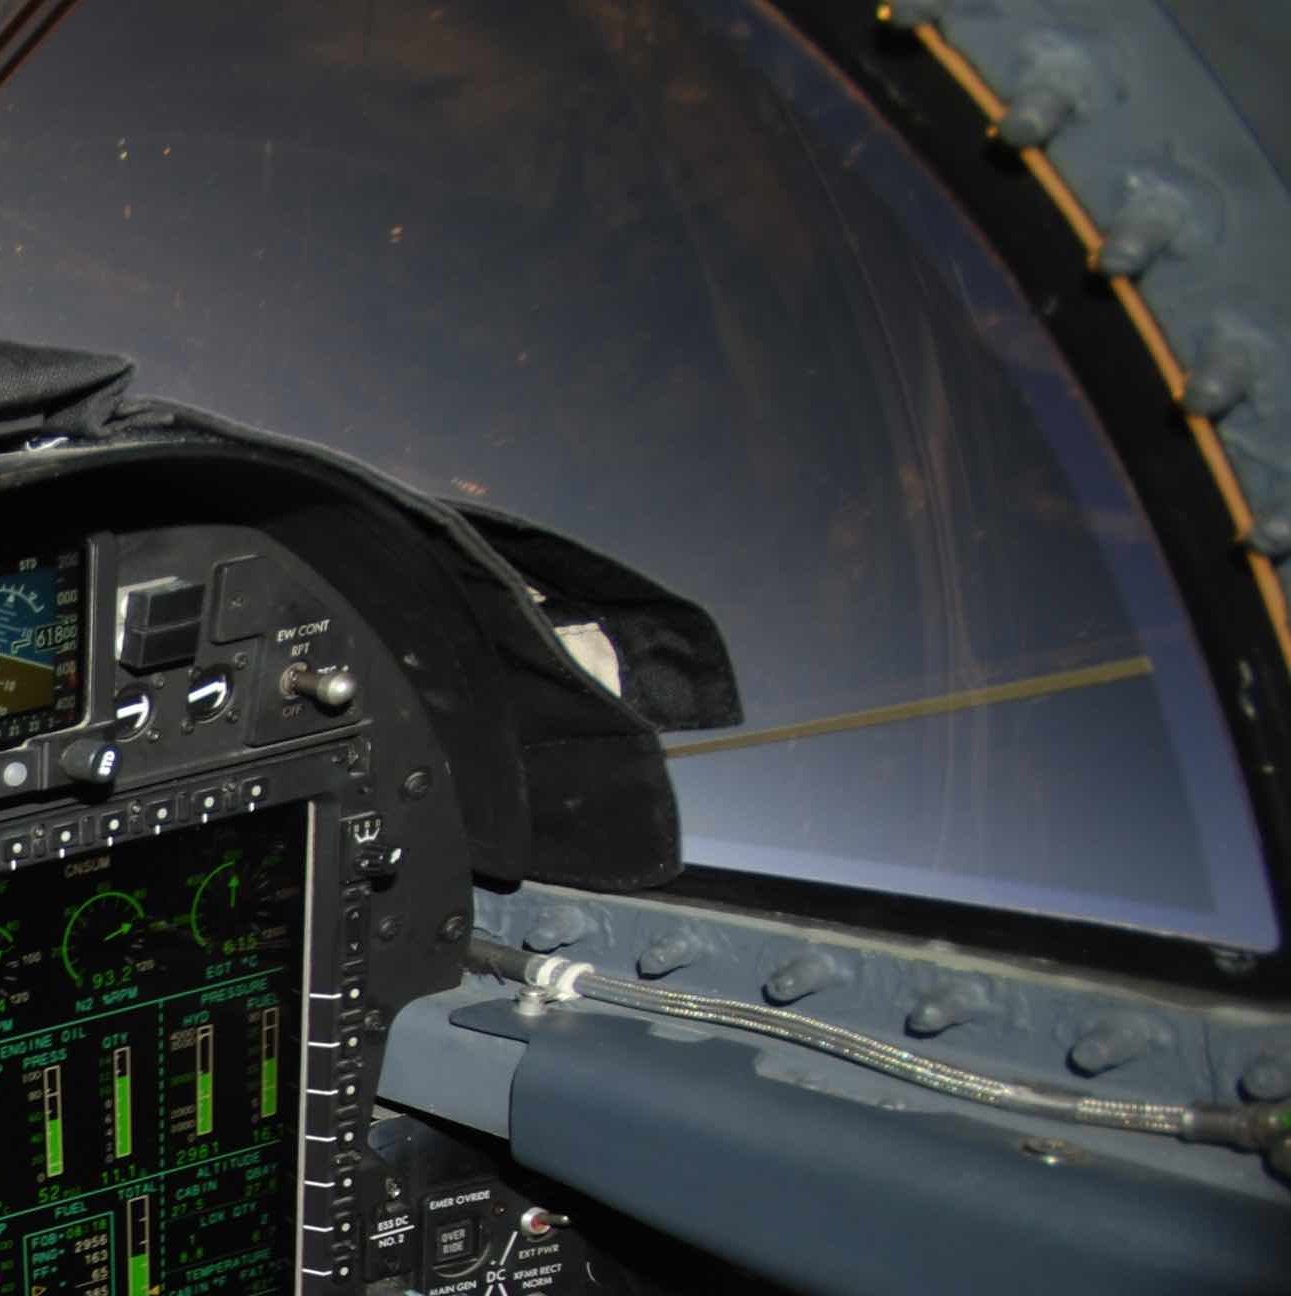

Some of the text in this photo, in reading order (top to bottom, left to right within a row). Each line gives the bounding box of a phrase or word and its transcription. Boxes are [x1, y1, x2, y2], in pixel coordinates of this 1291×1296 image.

[277, 619, 330, 642] EW CONT
[282, 704, 303, 719] OFF
[99, 749, 117, 775] STD
[200, 977, 269, 1006] PRESSURE
[0, 1026, 89, 1060] ENGINE OIL
[22, 1048, 69, 1071] PRESS
[101, 1031, 131, 1050] QTY
[196, 1151, 260, 1180] ALTITUDE
[117, 1181, 159, 1201] TOTAL
[429, 1189, 491, 1211] EMER OVRIDE
[53, 1202, 88, 1219] FUEL
[377, 1215, 409, 1232] ESS DC
[378, 1234, 405, 1249] NO. 2
[440, 1228, 466, 1243] OVER
[442, 1240, 464, 1255] RIDE
[536, 1243, 560, 1256] PWR
[486, 1268, 507, 1283] DC
[521, 1276, 553, 1290] NORM
[452, 1280, 477, 1294] GEN
